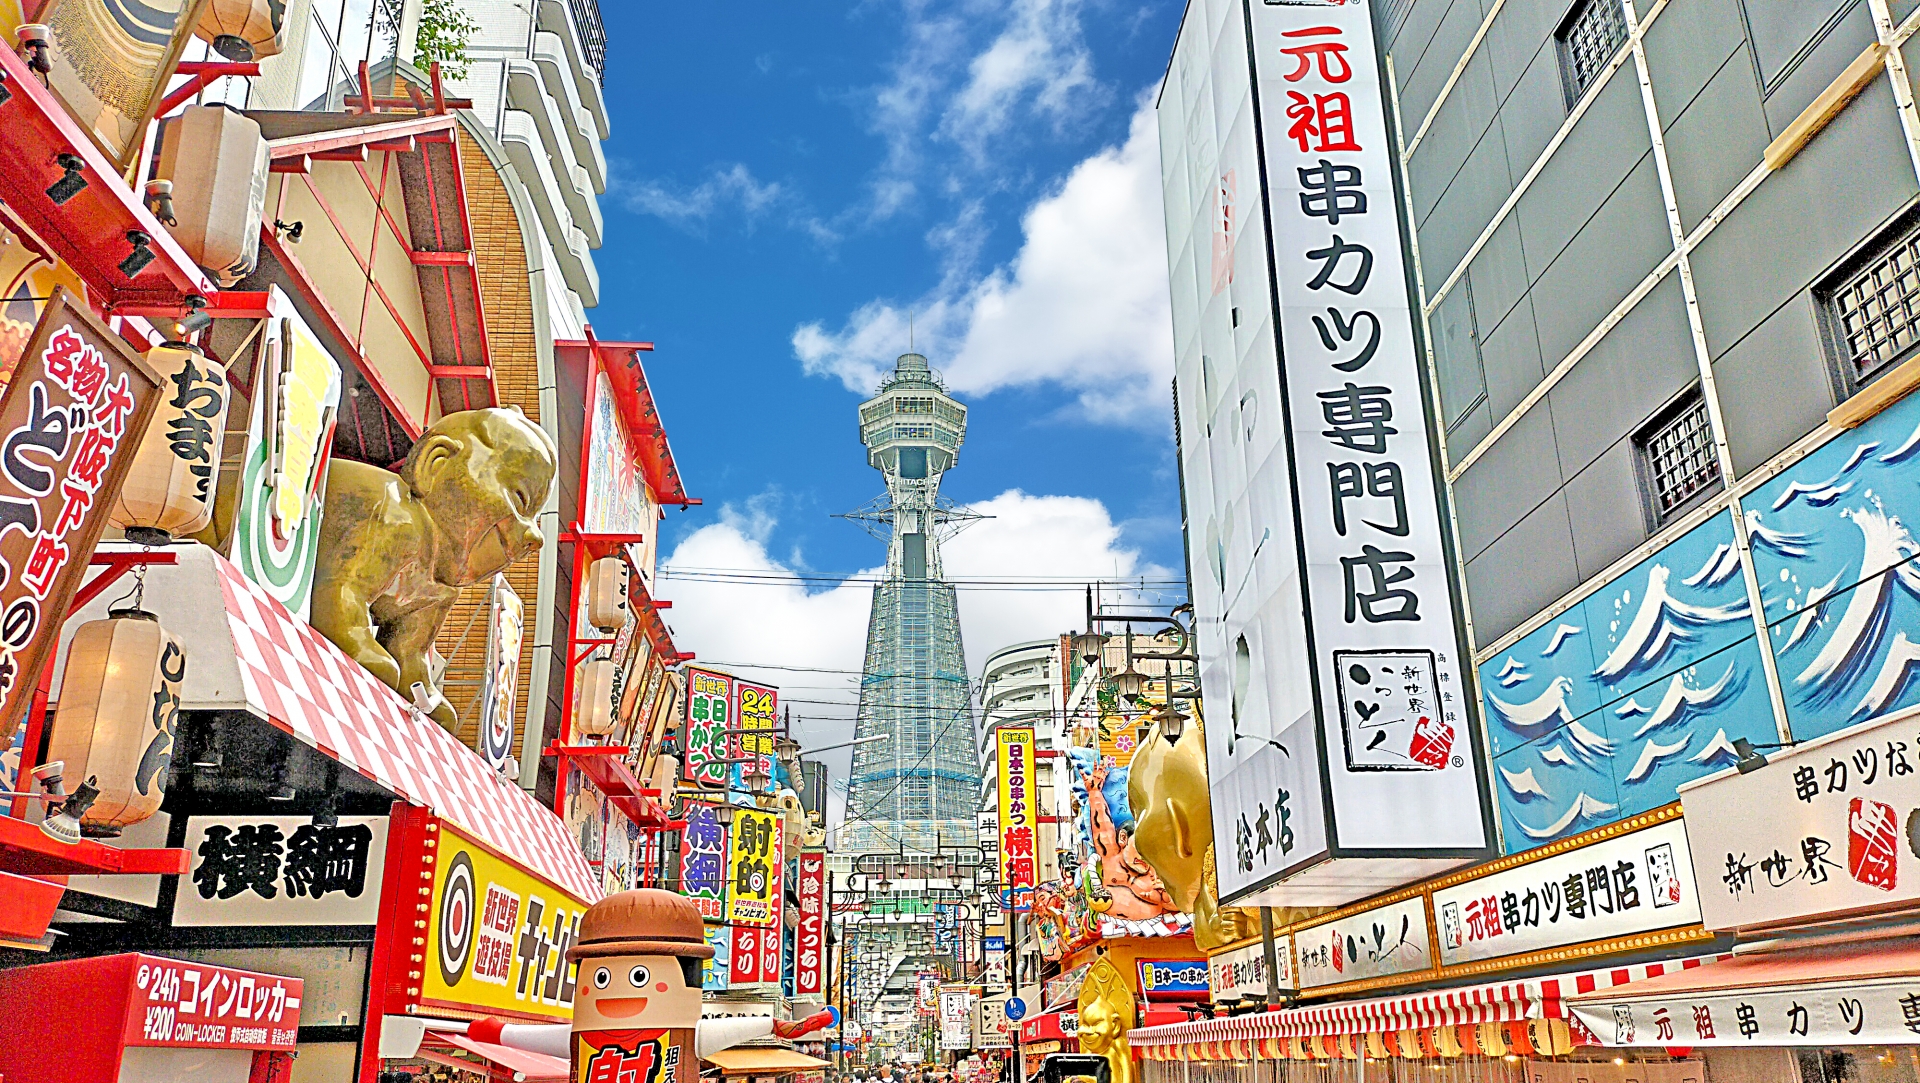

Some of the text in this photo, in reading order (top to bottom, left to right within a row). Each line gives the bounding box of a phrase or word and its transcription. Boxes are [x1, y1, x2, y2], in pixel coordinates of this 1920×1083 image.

[1280, 26, 1421, 624] 元祖串カツ専門店
[694, 675, 726, 697] 新世界
[1402, 665, 1429, 713] 新世界
[1437, 653, 1457, 722] 商標登録
[1008, 744, 1026, 825] 日本一の串かつ
[1793, 732, 1920, 804] 串カツな
[193, 824, 373, 899] 横綱
[685, 807, 722, 896] 横綱
[736, 814, 772, 899] 射的
[1003, 826, 1034, 888] 横綱
[1723, 836, 1843, 902] 新世界
[482, 884, 519, 936] 新世界
[734, 908, 768, 919] チャンピオン
[1465, 860, 1642, 943] 元祖串カツ専門店
[472, 933, 515, 981] 遊技場
[1302, 944, 1331, 968] 新世界
[144, 1006, 175, 1042] ¥200
[175, 1022, 226, 1043] COIN-LOCKER
